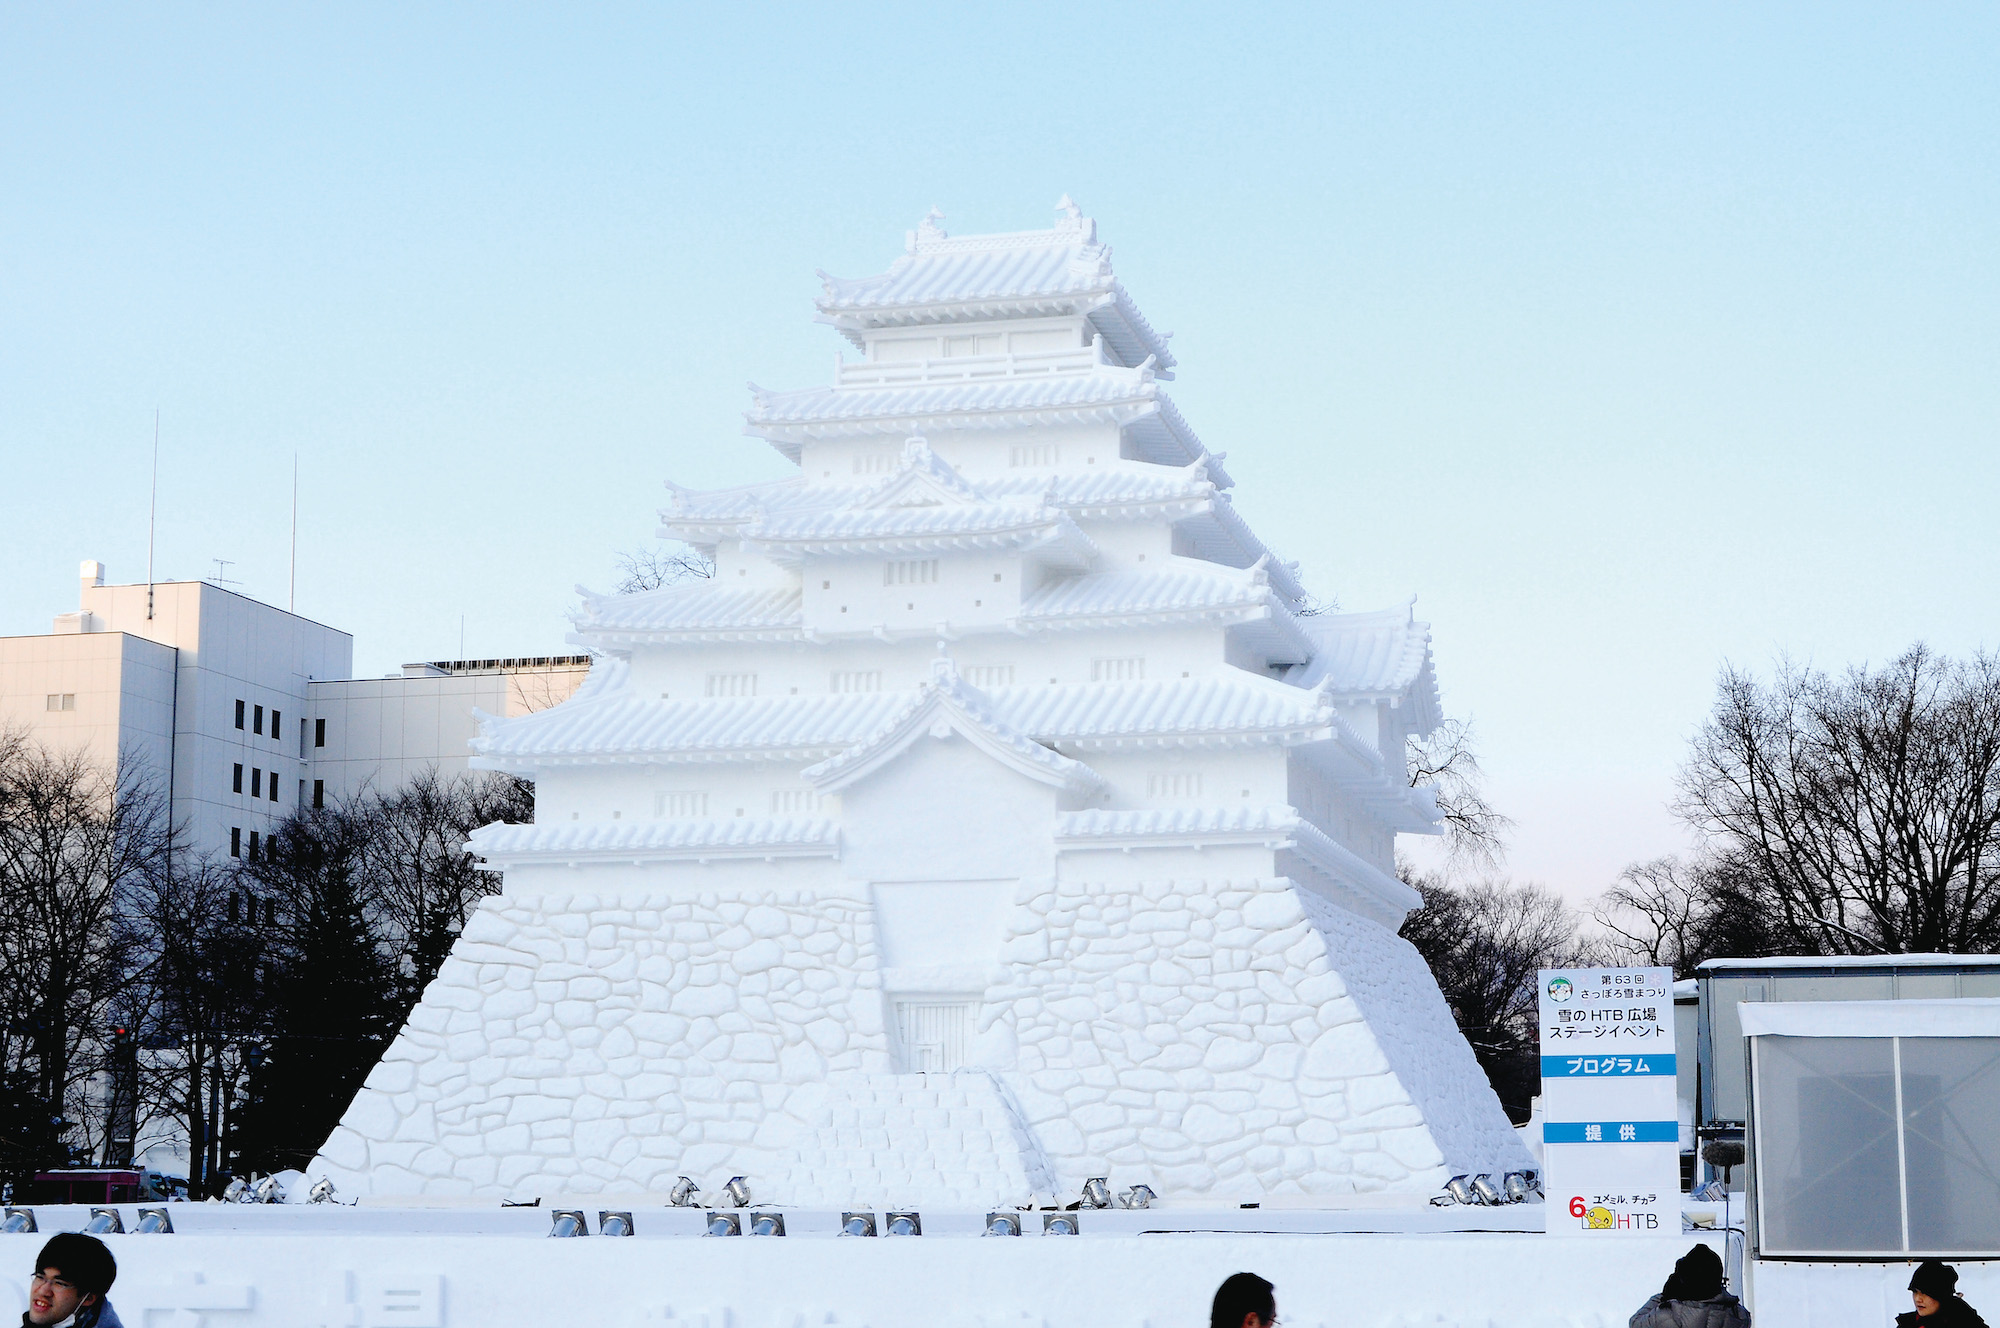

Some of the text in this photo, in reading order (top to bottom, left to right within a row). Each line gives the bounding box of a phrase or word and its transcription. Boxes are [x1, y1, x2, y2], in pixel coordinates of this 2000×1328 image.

[1580, 988, 1667, 999] さっぽろ雪まつり
[1550, 1025, 1665, 1039] ステージイベント
[1566, 1057, 1651, 1074] プログラム
[1569, 1196, 1587, 1218] 6
[1617, 1213, 1659, 1230] HTB
